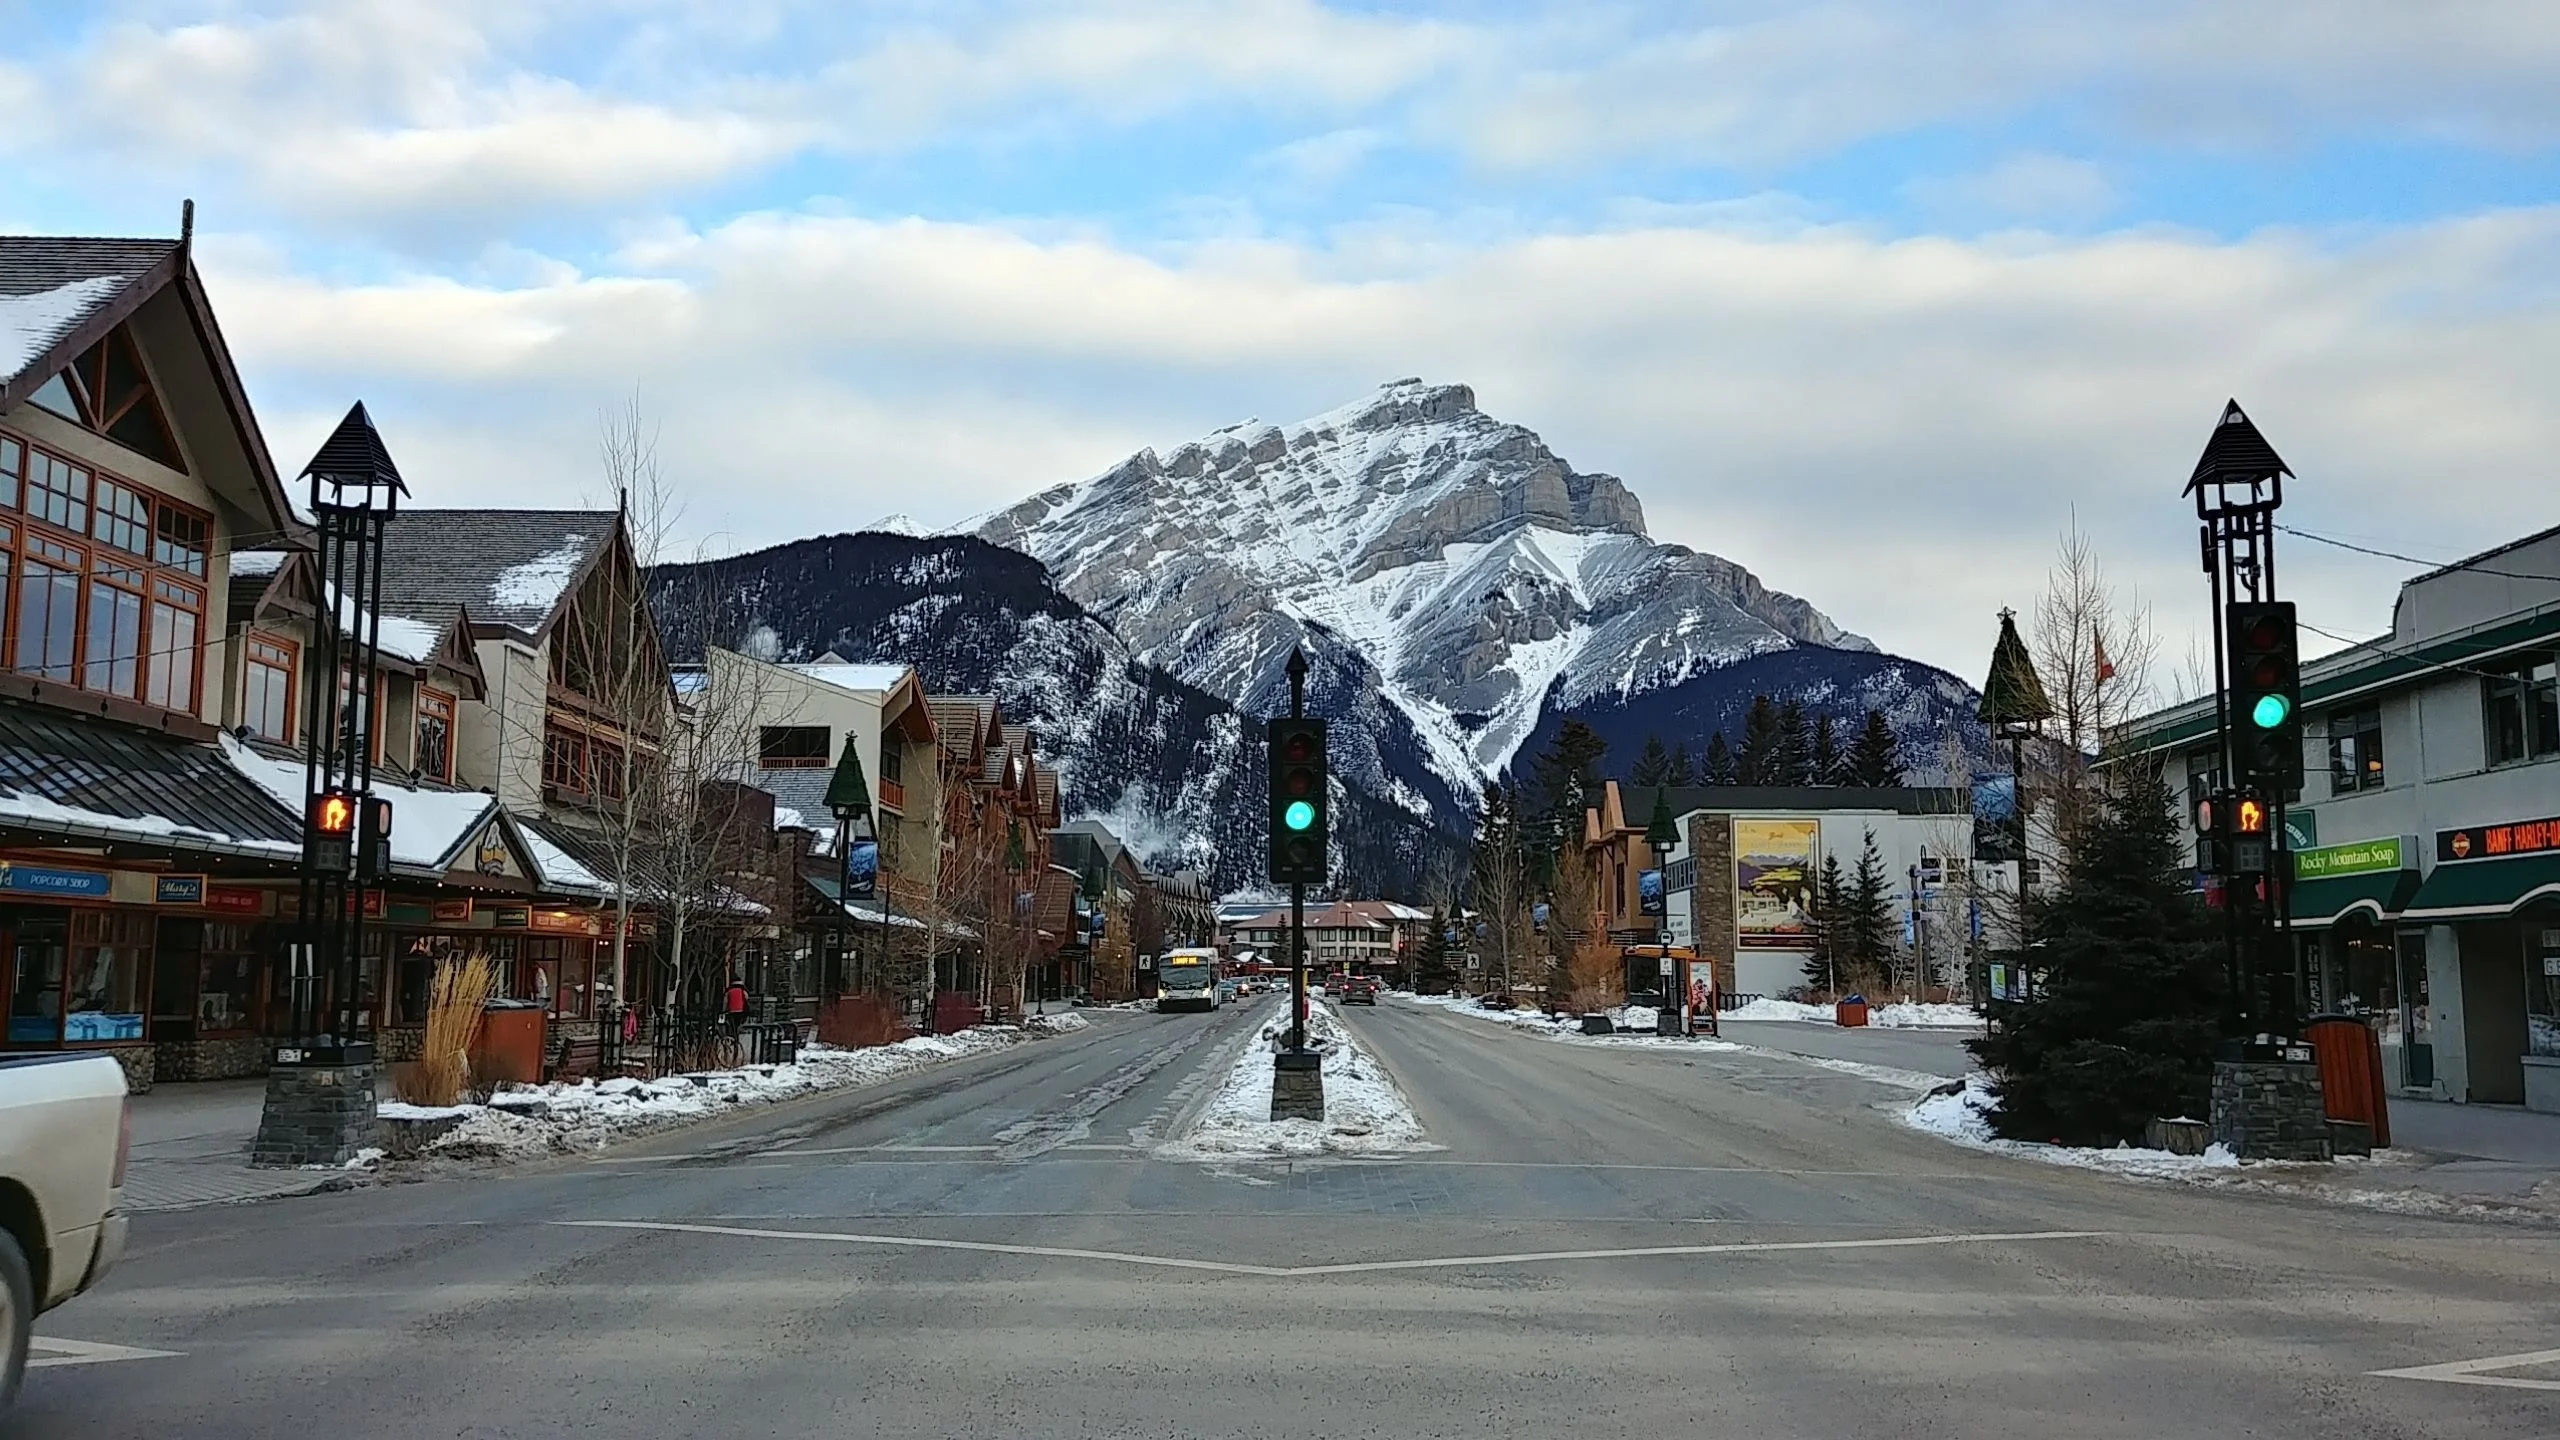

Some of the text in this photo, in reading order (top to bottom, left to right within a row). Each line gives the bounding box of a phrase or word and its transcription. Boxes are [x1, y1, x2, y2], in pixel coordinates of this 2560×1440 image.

[2485, 827, 2512, 854] BANFF
[2300, 845, 2395, 873] Rocky Mountain Soap
[30, 874, 68, 887] POPCORN
[69, 877, 91, 889] SHOP
